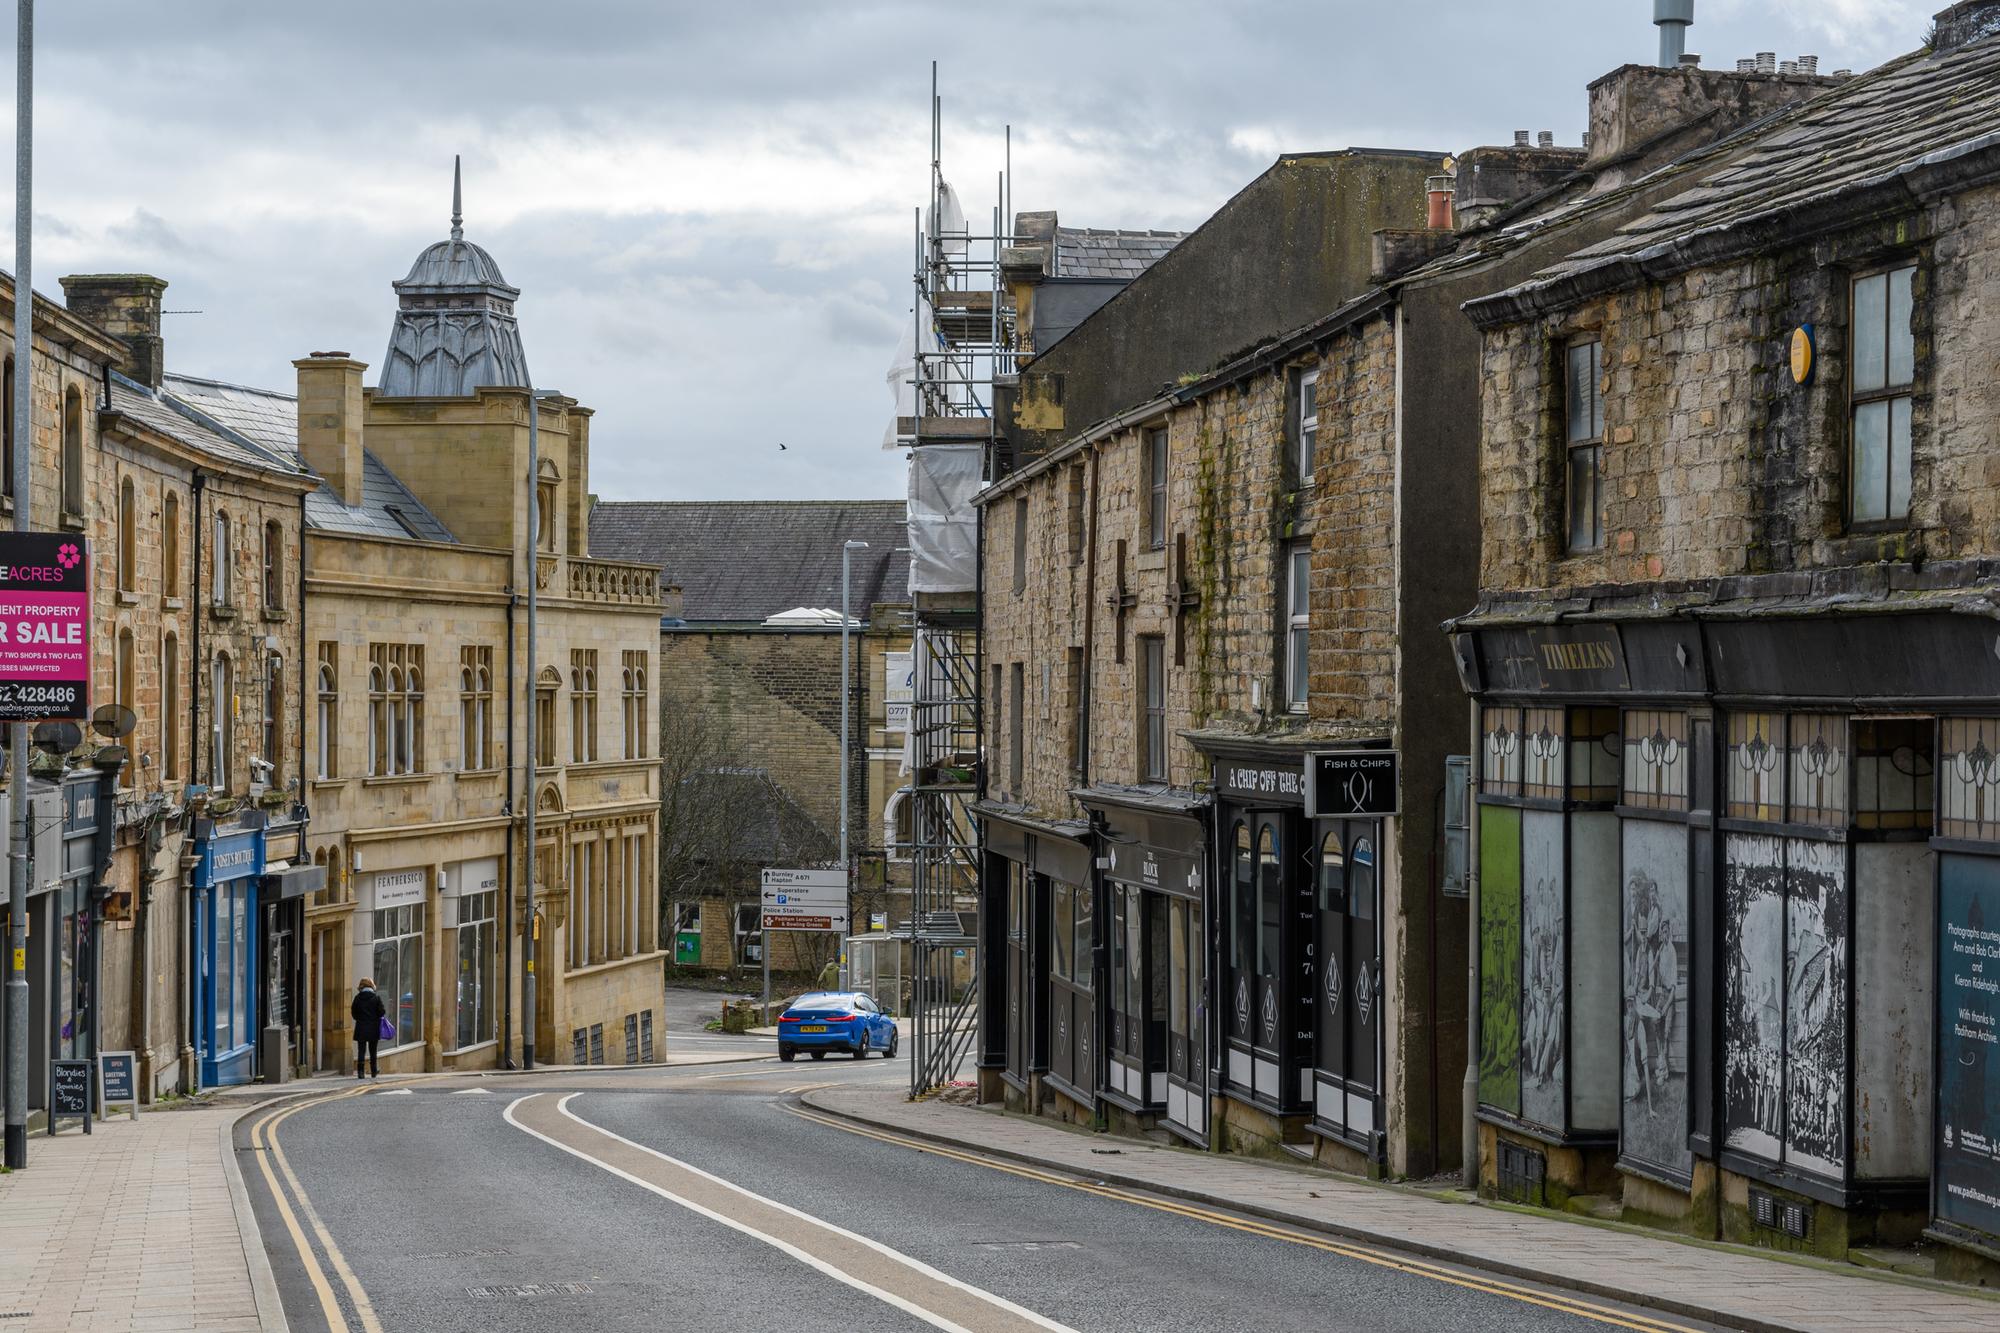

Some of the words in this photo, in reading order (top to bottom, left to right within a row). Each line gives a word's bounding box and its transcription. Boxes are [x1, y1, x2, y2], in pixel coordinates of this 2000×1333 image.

[0, 605, 22, 615] ENT
[25, 605, 80, 617] PROPERTY
[16, 621, 82, 644] SALE
[20, 652, 41, 660] SHOPS
[1540, 640, 1615, 670] TIMELESS
[19, 664, 60, 672] UNAFFECTED
[17, 686, 76, 703] 428486
[1350, 760, 1358, 768] &
[1229, 768, 1236, 788] A
[1237, 769, 1258, 790] CHIP
[1260, 770, 1277, 793] OFF
[1278, 771, 1298, 794] THE
[1143, 861, 1159, 877] BLOCK
[1947, 922, 1980, 940] Photographs
[1953, 941, 1964, 953] Ann
[1965, 944, 1976, 955] and
[1976, 944, 1987, 957] Bob
[1972, 961, 1983, 973] and
[1959, 1008, 1971, 1020] With
[1971, 1010, 1989, 1025] thanks
[1990, 1015, 1996, 1026] to
[1954, 1023, 1977, 1039] Padiham
[56, 1066, 86, 1078] Blondies
[56, 1083, 84, 1092] Brownies
